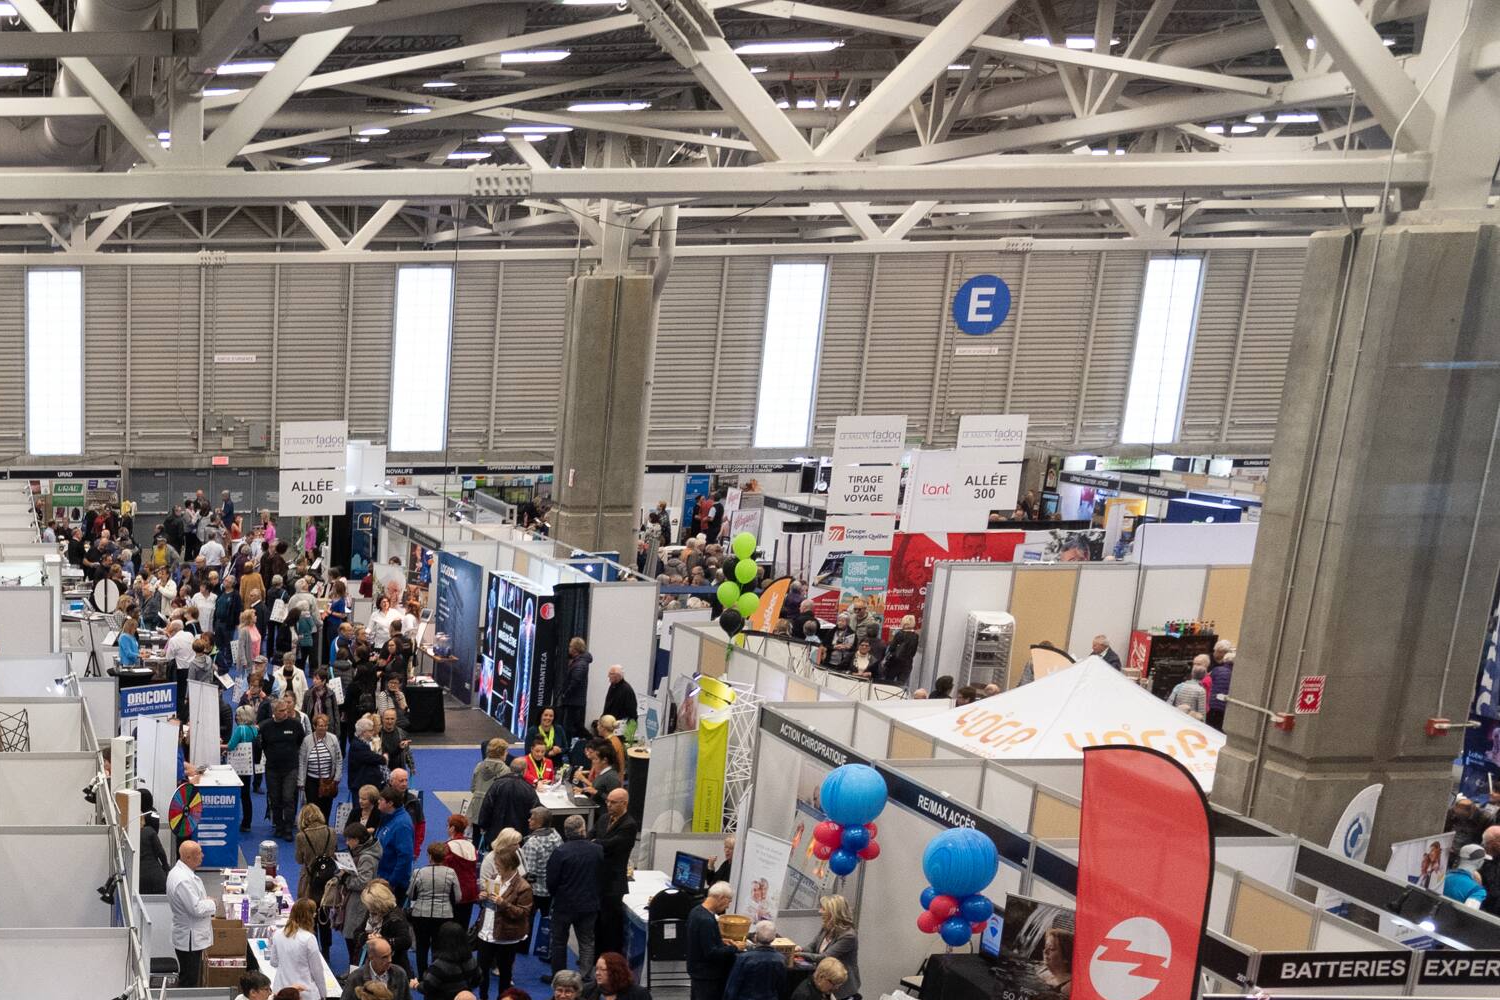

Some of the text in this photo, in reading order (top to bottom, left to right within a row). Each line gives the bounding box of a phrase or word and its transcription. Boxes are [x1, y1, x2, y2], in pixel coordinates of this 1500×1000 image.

[967, 287, 996, 322] E
[316, 434, 344, 447] fadoq
[872, 430, 901, 442] fadoq
[994, 429, 1023, 441] fadoq
[291, 478, 333, 492] ALLÉE
[849, 475, 884, 483] TIRAGE
[964, 472, 1008, 486] ALLÉE
[853, 485, 876, 493] D'UN
[973, 488, 996, 499] 300
[301, 494, 323, 505] 200
[844, 494, 884, 502] VOYAGE
[780, 723, 848, 766] ACTION CHIROPRATIQUE
[201, 795, 236, 804] RICOM
[917, 794, 976, 831] RE/MAX ACCÈS
[1281, 960, 1500, 979] BATTERIES EXPER
